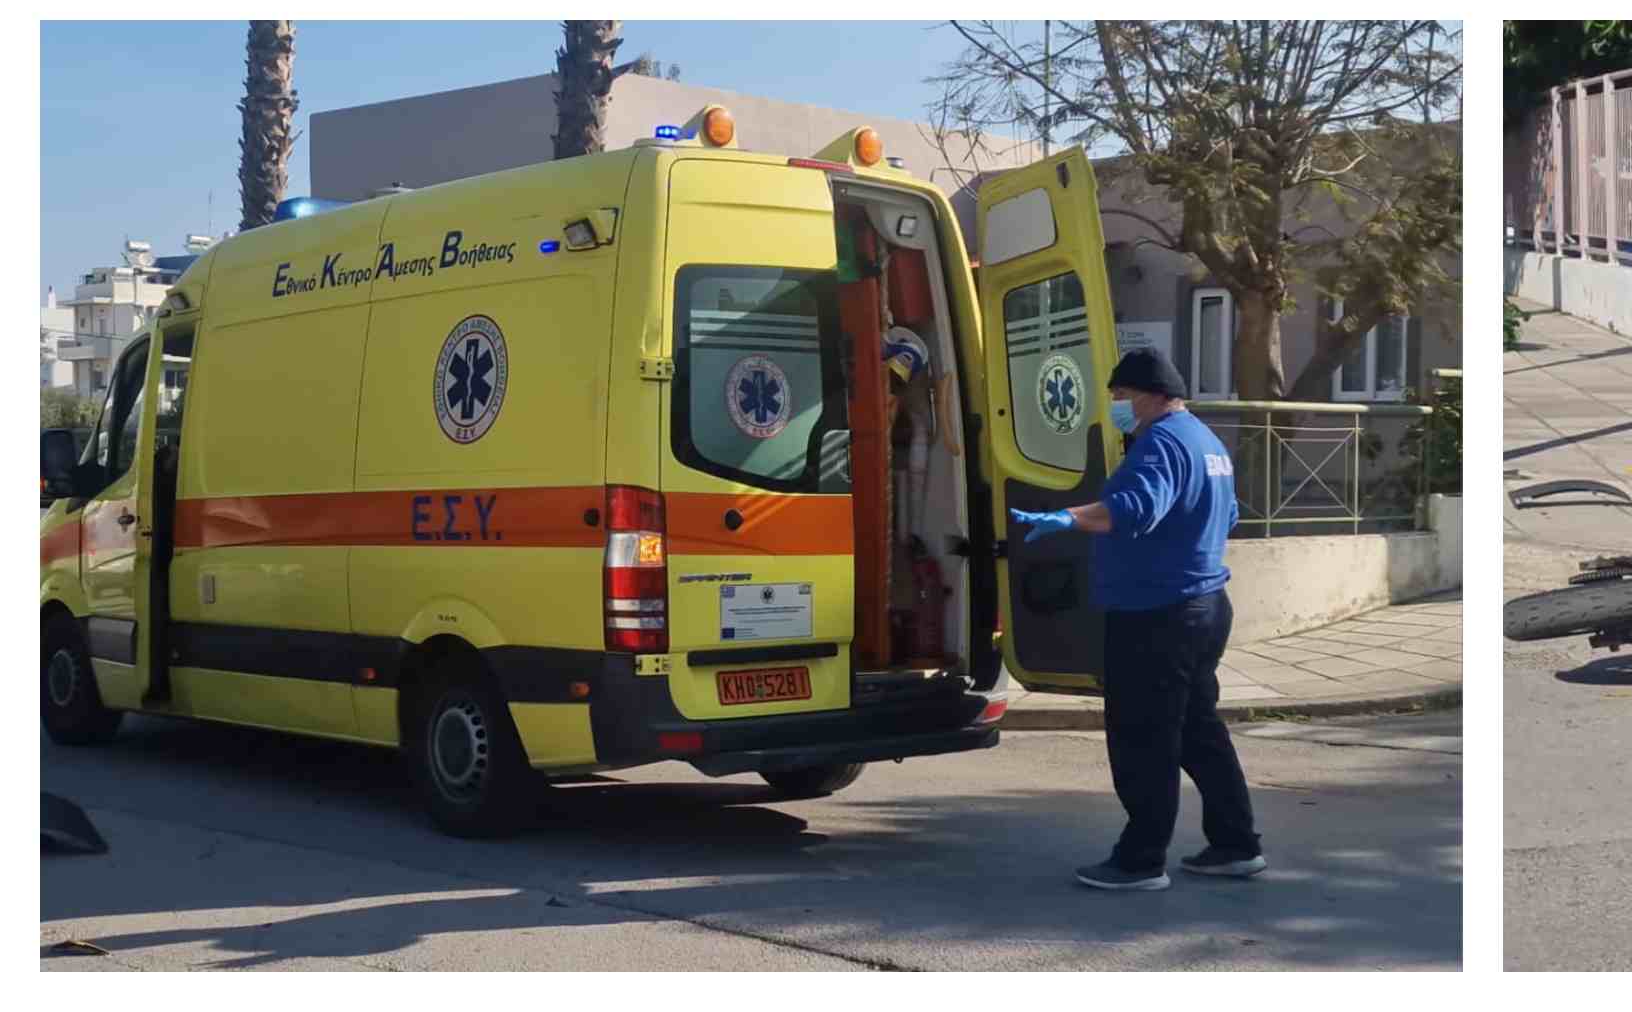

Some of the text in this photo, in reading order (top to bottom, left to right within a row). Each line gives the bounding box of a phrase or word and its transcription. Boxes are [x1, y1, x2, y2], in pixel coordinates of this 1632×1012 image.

[272, 230, 516, 297] Εθνικό Κέντρο Άμεσης Βοήθειας
